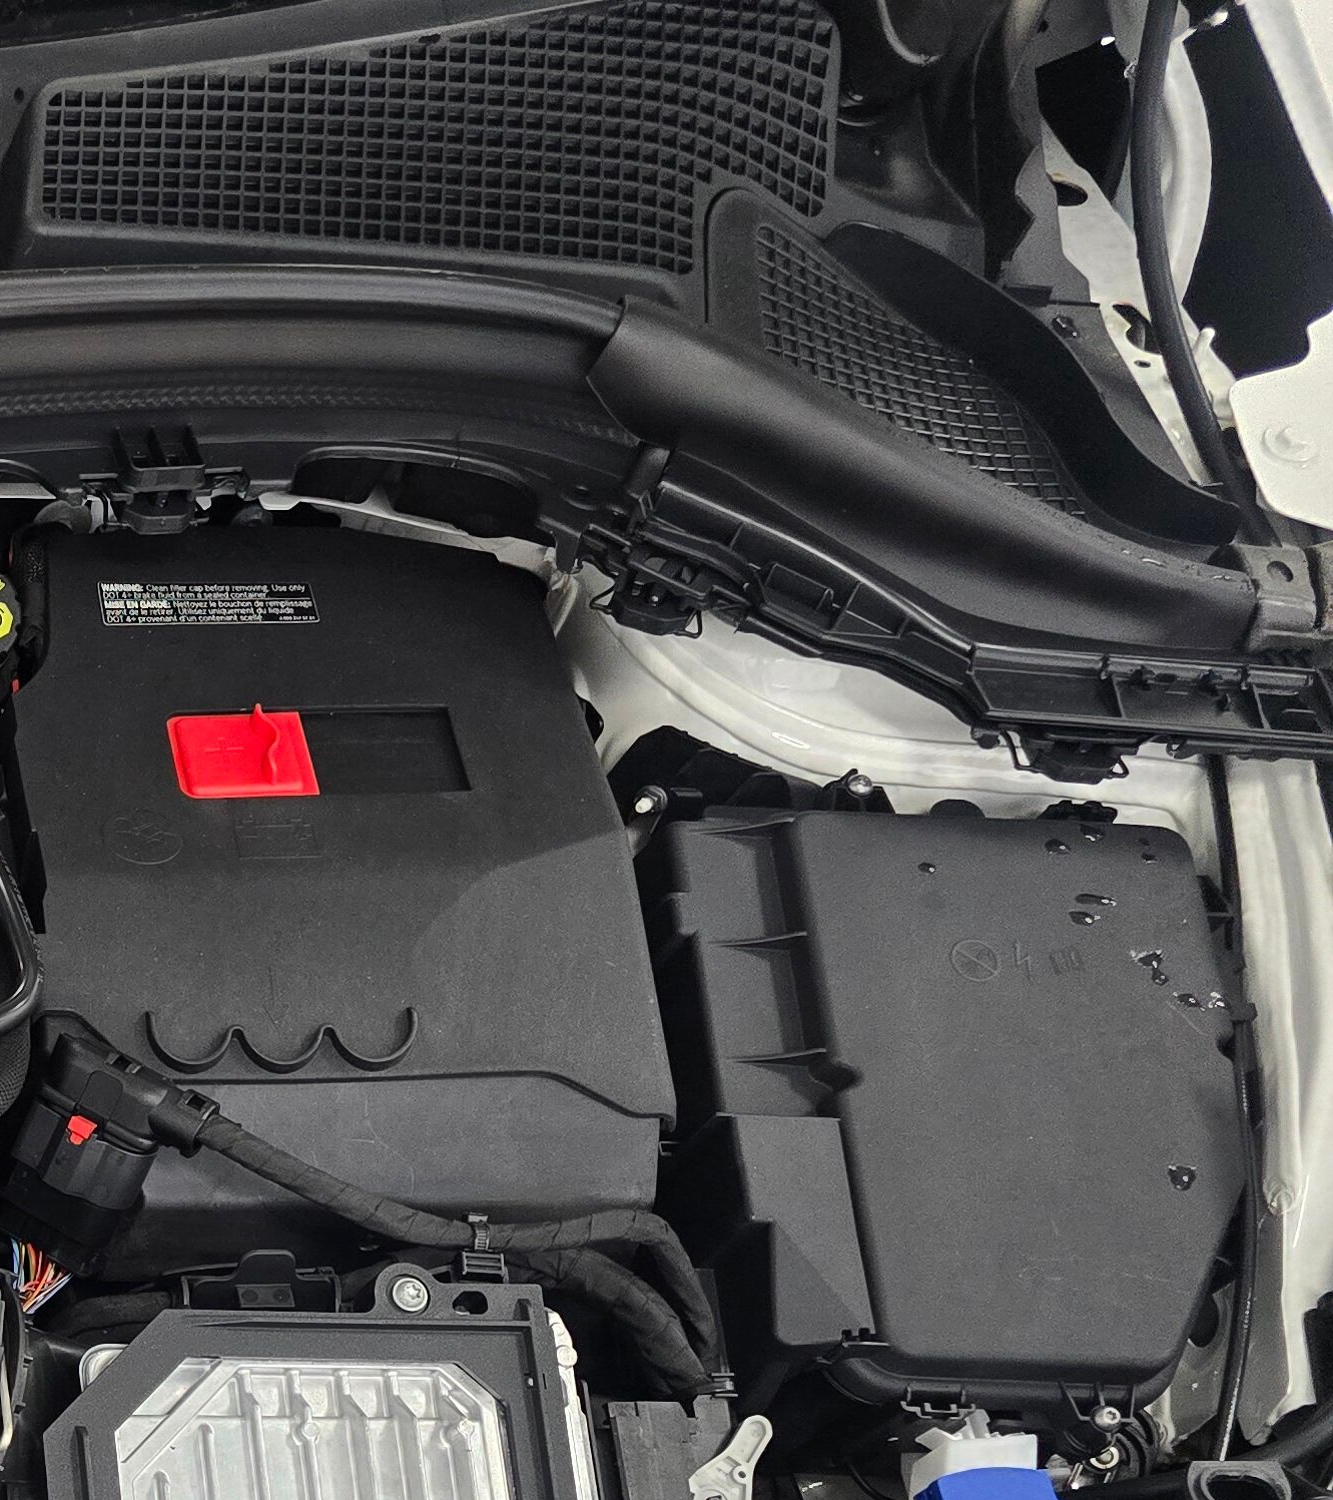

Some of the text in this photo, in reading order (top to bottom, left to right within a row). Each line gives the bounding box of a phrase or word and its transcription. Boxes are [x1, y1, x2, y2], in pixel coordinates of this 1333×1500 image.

[101, 584, 144, 592] WARNING:
[204, 584, 229, 592] before
[271, 584, 287, 592] Use
